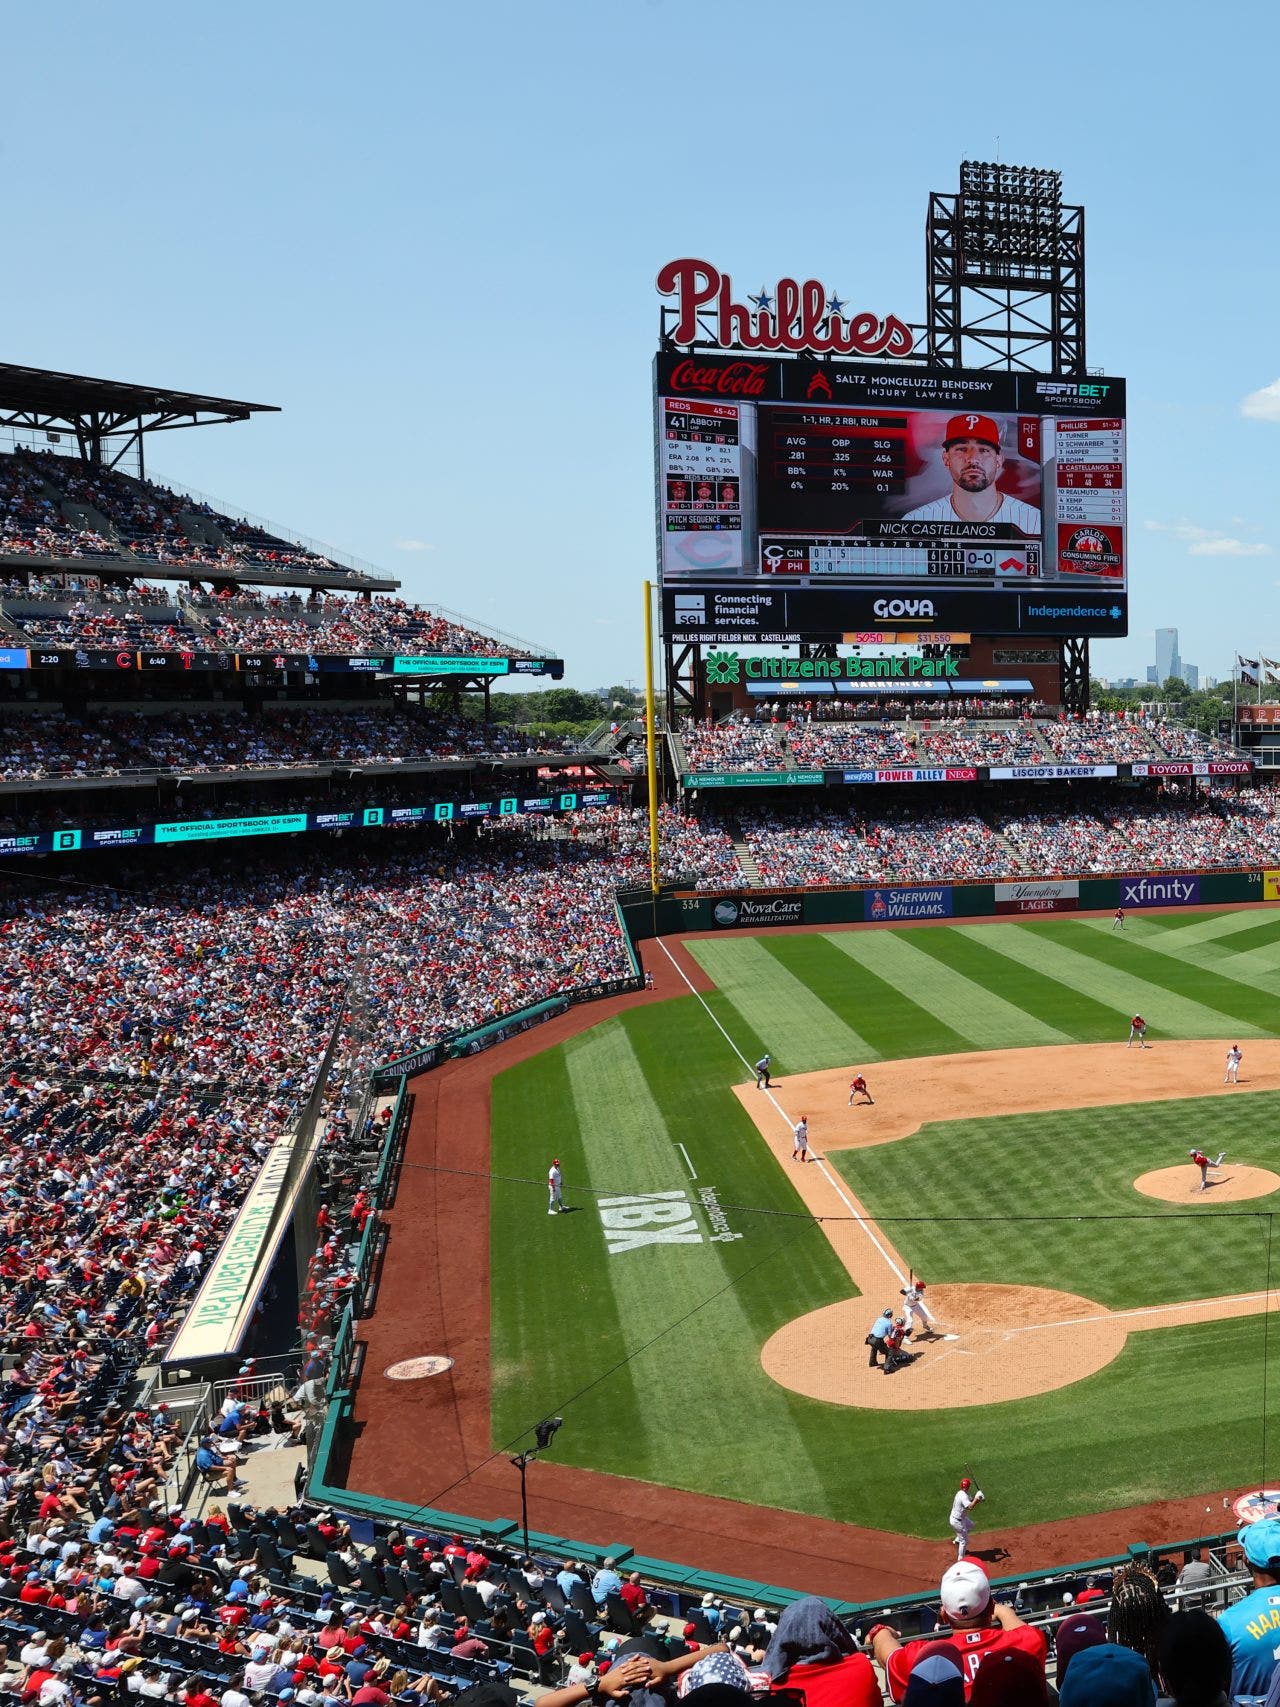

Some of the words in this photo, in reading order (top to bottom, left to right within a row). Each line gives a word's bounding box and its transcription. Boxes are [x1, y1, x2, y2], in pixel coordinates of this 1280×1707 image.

[656, 257, 914, 357] Phillies
[670, 360, 771, 394] Coca-Cola
[836, 374, 866, 384] SALTZ
[872, 376, 936, 388] MONGELUZZI
[941, 380, 993, 392] BENDESKY
[868, 388, 906, 396] INJURY
[915, 391, 964, 400] LAWYERS
[1044, 396, 1101, 404] SPORTSBOOK
[670, 402, 690, 410] REDS
[713, 408, 736, 416] 45-42
[670, 416, 685, 428] 41
[690, 418, 722, 427] ABBOTT
[802, 416, 817, 424] 1-1,
[819, 417, 834, 425] HR,
[842, 418, 858, 426] RBI,
[1023, 423, 1036, 434] RF
[832, 439, 850, 447] OBP
[874, 440, 890, 448] SLG
[1026, 438, 1034, 448] 8
[788, 452, 805, 460] .281
[832, 454, 850, 462] .325
[874, 454, 892, 462] .456
[872, 470, 894, 478] WAR
[790, 482, 804, 490] 6%
[688, 516, 720, 524] SEQUENCE
[880, 523, 910, 535] NICK
[912, 524, 996, 536] CASTELLANOS
[786, 550, 803, 558] CIN
[968, 552, 992, 564] 0-0
[1062, 552, 1101, 560] CONSUMING
[788, 562, 803, 570] PHI
[714, 594, 772, 606] Connecting
[714, 605, 759, 614] financial
[874, 600, 934, 618] GOYA
[1028, 606, 1107, 618] Independence
[714, 616, 759, 625] services.
[672, 634, 698, 642] PHILLIES
[700, 634, 717, 642] RIGHT
[718, 634, 742, 642] FIELDER
[742, 634, 757, 642] NICK
[917, 634, 951, 643] $31,550
[40, 656, 58, 664] 2:20
[745, 656, 842, 678] Citizens
[846, 655, 904, 677] Bank
[909, 656, 960, 677] Park
[1012, 768, 1054, 778] LISCIO'S
[1056, 766, 1096, 776] BAKERY
[1152, 765, 1190, 774] TOYOTA
[1212, 764, 1249, 772] TOYOTA
[878, 771, 913, 781] POWER
[916, 770, 944, 780] ALLEY
[950, 769, 975, 778] NECA
[160, 825, 177, 833] THE
[179, 822, 214, 832] OFFICIAL
[216, 818, 270, 830] SPORTSBOOK
[1248, 872, 1261, 882] 374
[1011, 884, 1064, 900] Yuengling
[1124, 878, 1195, 903] xfinity
[888, 890, 943, 904] SHERWIN
[682, 900, 700, 910] 334
[740, 900, 802, 916] NovaCare
[1020, 900, 1054, 910] LAGER
[740, 914, 800, 923] REHABILITATION
[598, 1190, 704, 1254] IBX
